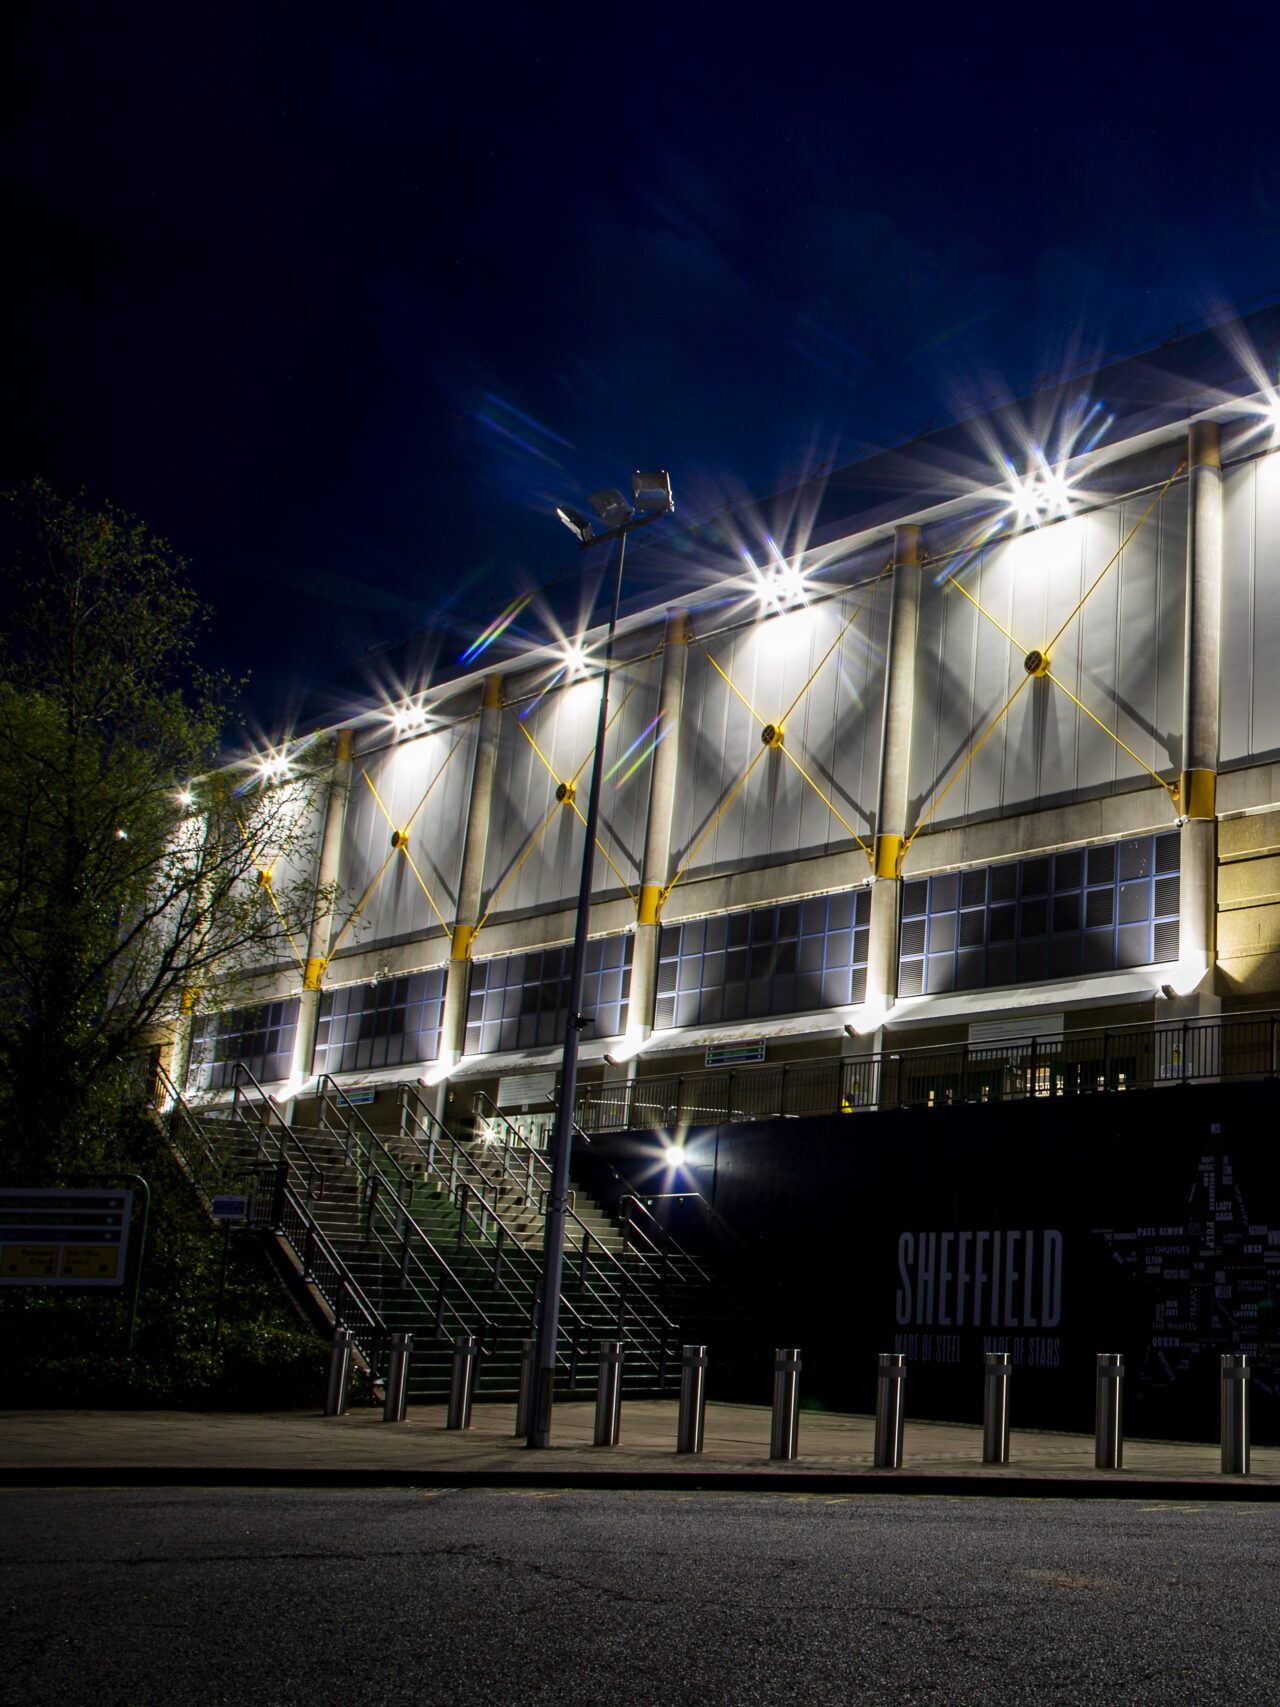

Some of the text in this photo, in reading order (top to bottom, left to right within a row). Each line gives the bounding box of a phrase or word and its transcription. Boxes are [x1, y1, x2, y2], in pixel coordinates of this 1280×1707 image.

[1216, 1201, 1232, 1211] LADY
[1215, 1211, 1234, 1221] GAGA
[1137, 1227, 1156, 1237] PAUL
[1159, 1226, 1184, 1237] SIMON
[1206, 1221, 1215, 1249] PULP
[1154, 1245, 1190, 1255] THUNDER
[1145, 1256, 1163, 1265] ELTON
[896, 1229, 1063, 1328] SHEFFIELD
[1152, 1336, 1180, 1348] QUEEN
[894, 1333, 961, 1363] MADE OF STEEL
[1013, 1336, 1026, 1366] OF
[1028, 1337, 1061, 1367] STARS
